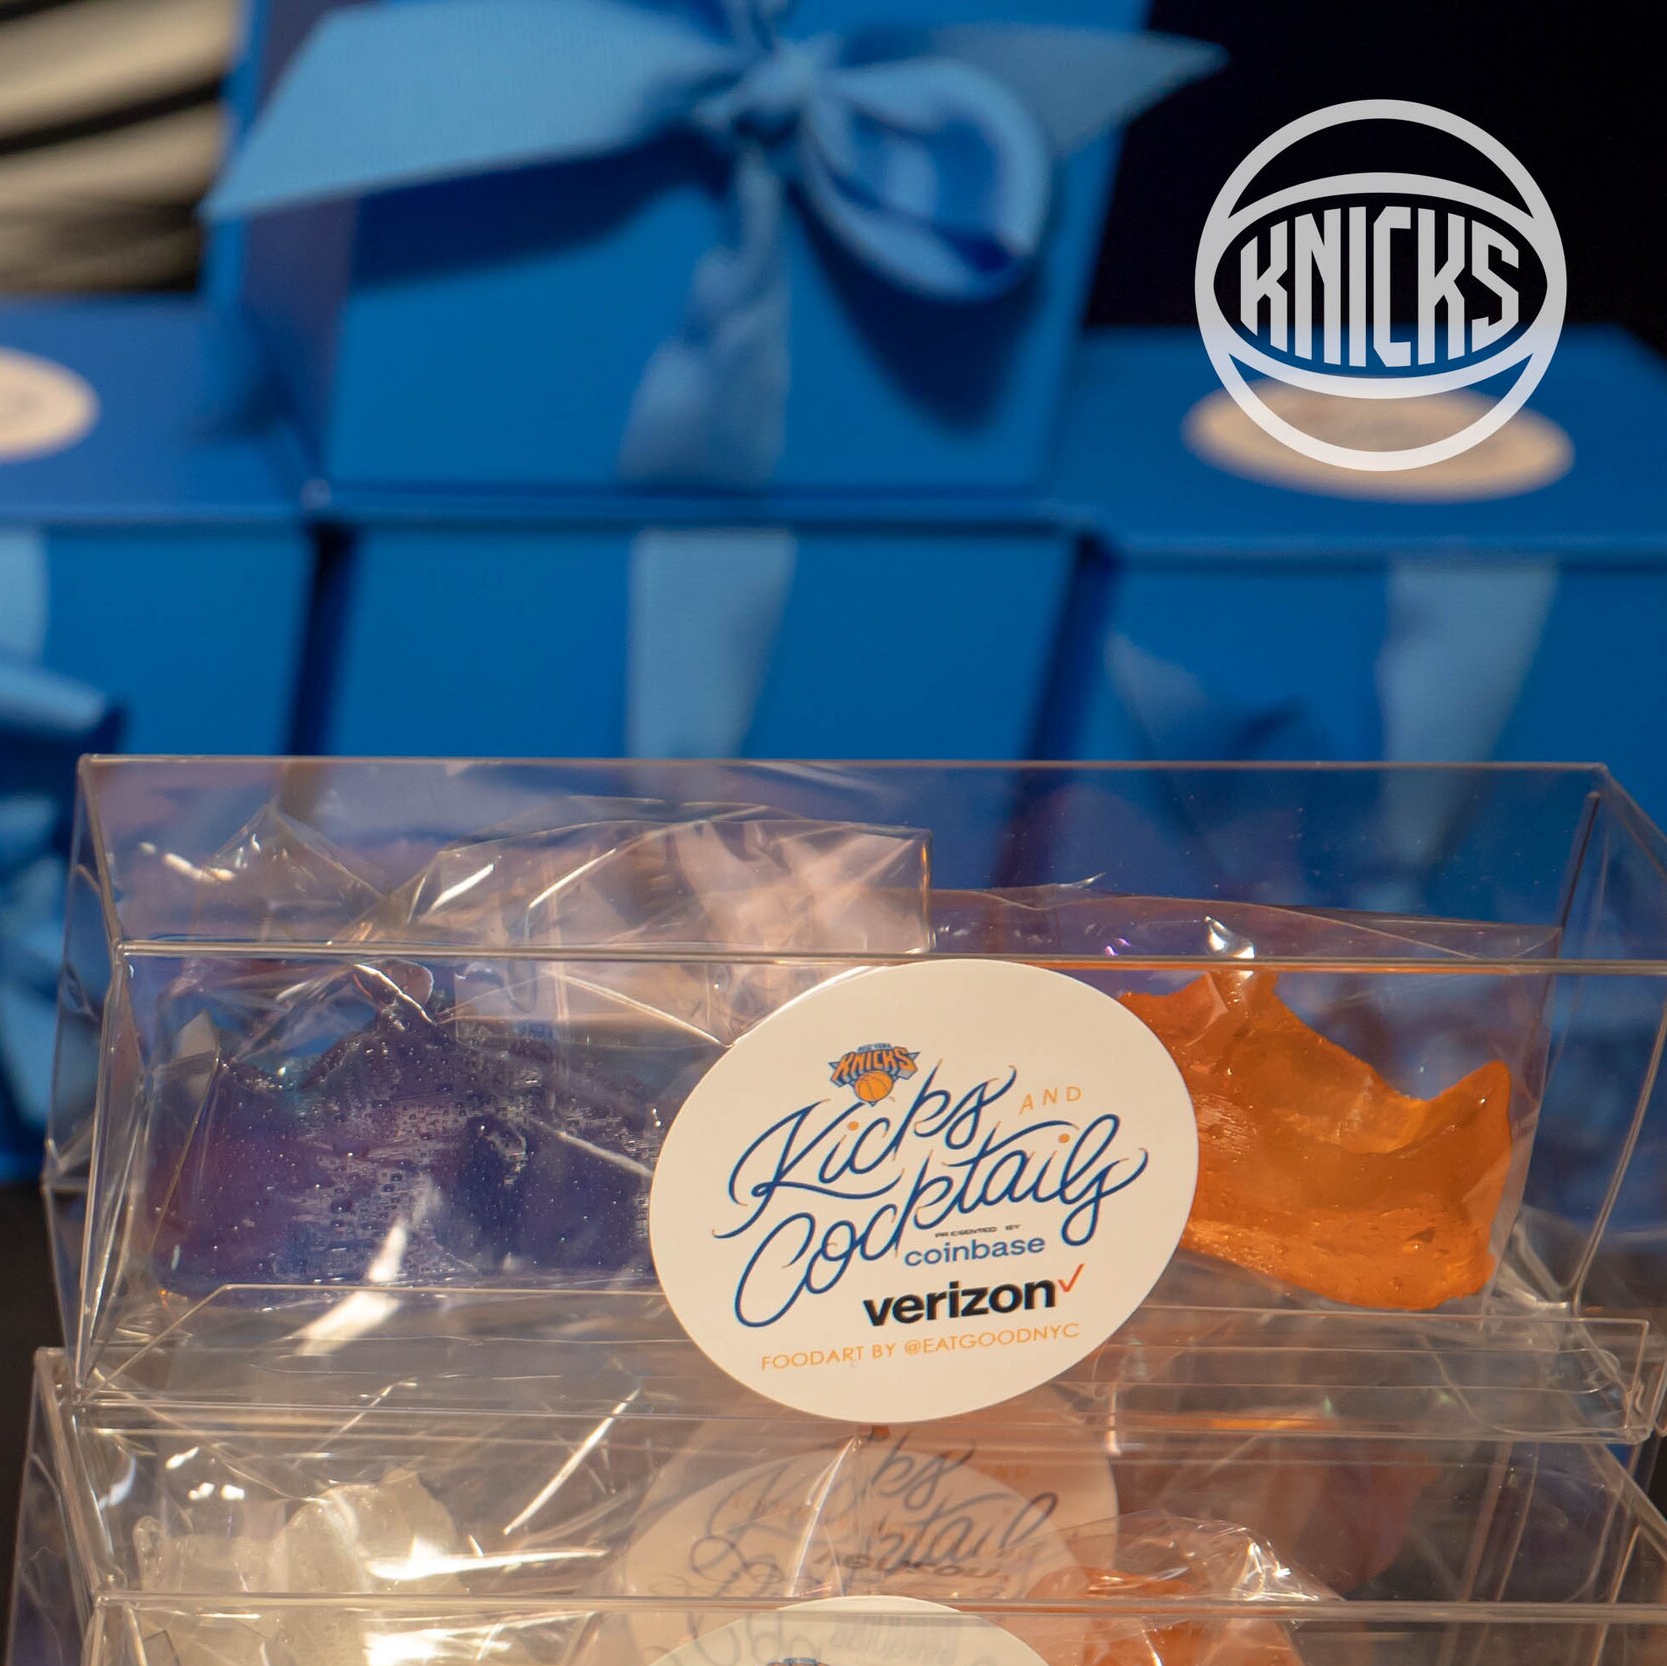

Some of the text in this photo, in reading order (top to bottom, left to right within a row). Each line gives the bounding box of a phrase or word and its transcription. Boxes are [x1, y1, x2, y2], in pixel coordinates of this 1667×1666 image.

[831, 1046, 918, 1082] KNICKS
[712, 1058, 1083, 1239] Kicks AND
[734, 1114, 1149, 1328] Cocktails
[904, 1237, 1046, 1267] coinbase
[862, 1279, 1057, 1327] verizon
[760, 1322, 1081, 1371] FOODART BY @EATGOODNYC
